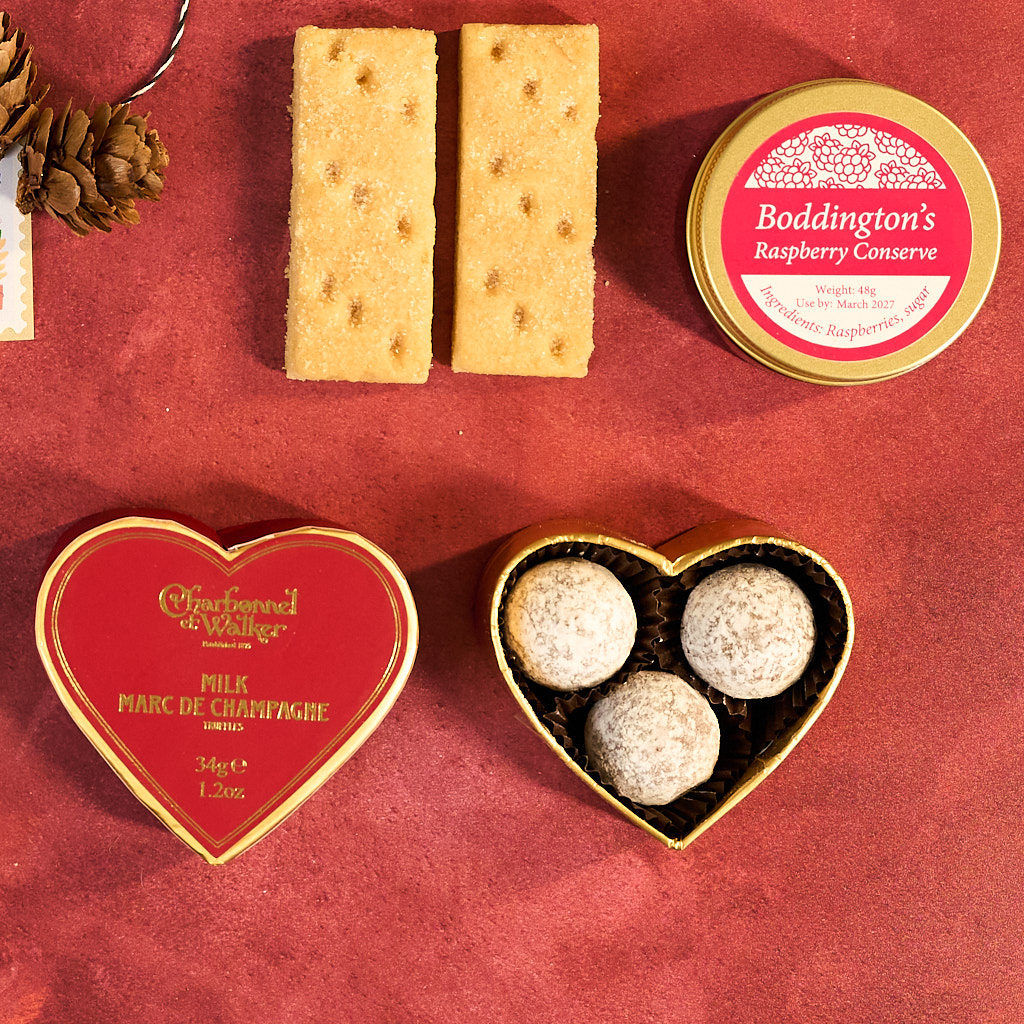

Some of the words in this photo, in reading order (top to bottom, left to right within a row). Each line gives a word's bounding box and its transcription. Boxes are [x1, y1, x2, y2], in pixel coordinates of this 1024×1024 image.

[755, 202, 936, 240] Boddington's
[754, 241, 848, 266] Raspberry
[853, 241, 938, 261] Conserve
[815, 284, 855, 297] Weight:
[857, 284, 877, 298] 48g
[759, 284, 823, 335] Ingredients:
[826, 314, 904, 341] Raspberries,
[904, 284, 932, 317] sugar
[796, 298, 814, 309] Use
[816, 297, 833, 311] by:
[837, 298, 869, 309] March
[871, 299, 895, 309] 2027
[158, 583, 298, 618] Charbonnel
[179, 614, 198, 630] et
[198, 613, 288, 644] Walker
[201, 673, 249, 695] MILK
[118, 693, 174, 715] MARC
[179, 696, 205, 716] DE
[210, 697, 330, 722] CHAMPAGNE
[195, 756, 228, 778] 34g
[199, 781, 245, 799] 1.2oz
